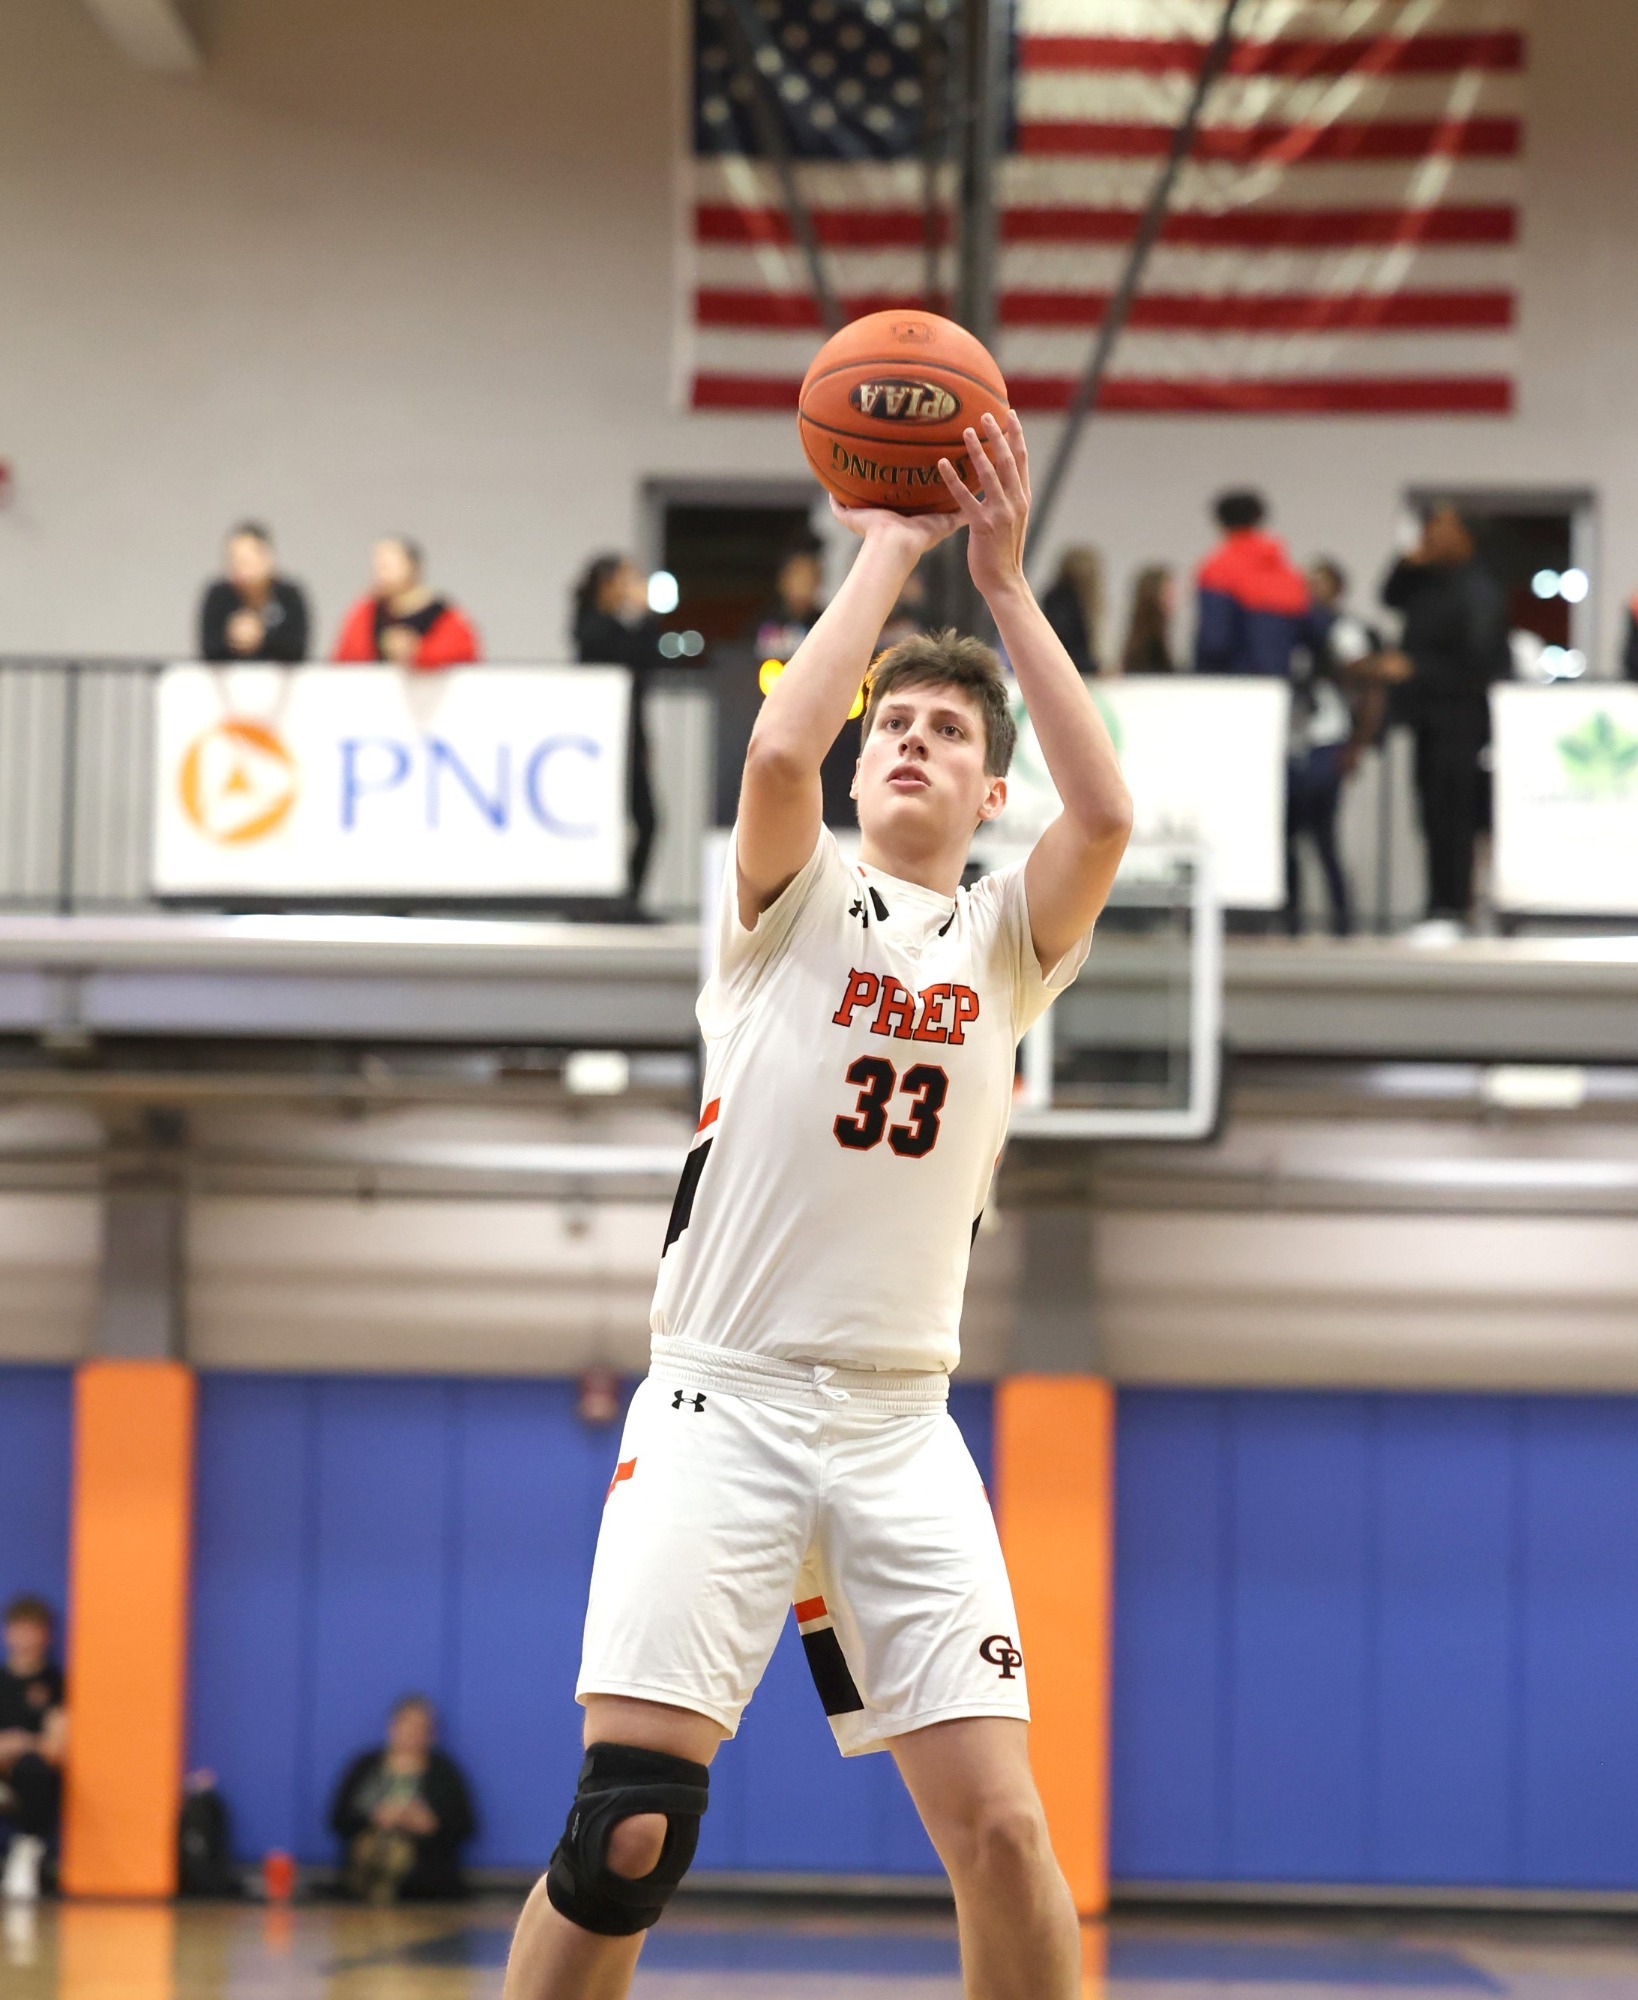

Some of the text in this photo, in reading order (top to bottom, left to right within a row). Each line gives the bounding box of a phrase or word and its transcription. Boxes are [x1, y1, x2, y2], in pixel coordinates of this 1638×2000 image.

[860, 383, 941, 418] PIAA
[339, 735, 602, 839] PNC
[832, 967, 980, 1045] PREP
[833, 1055, 949, 1159] 33
